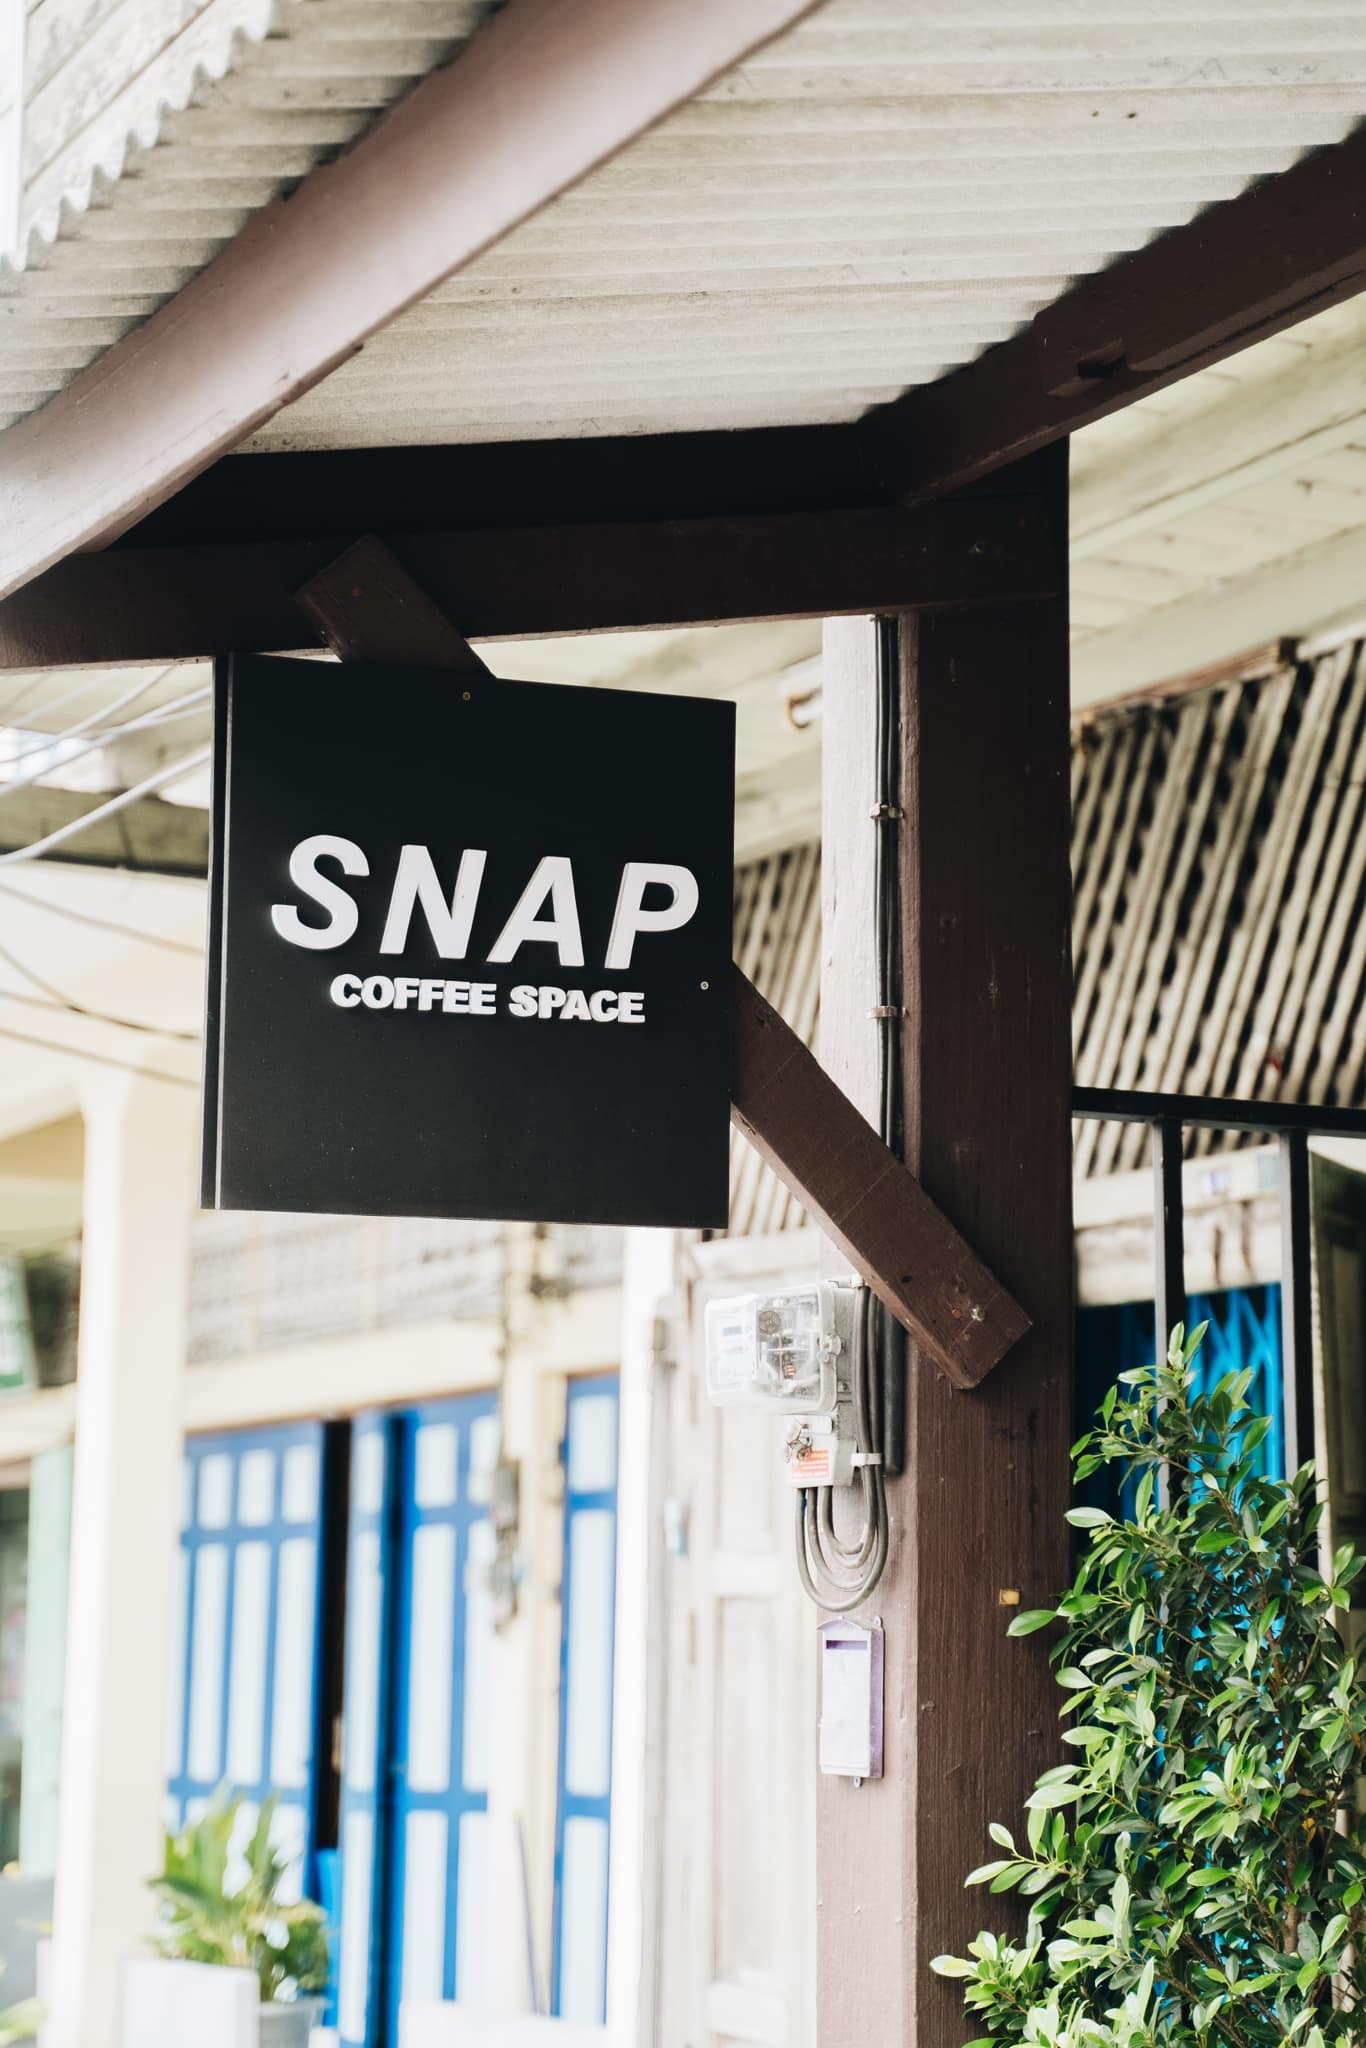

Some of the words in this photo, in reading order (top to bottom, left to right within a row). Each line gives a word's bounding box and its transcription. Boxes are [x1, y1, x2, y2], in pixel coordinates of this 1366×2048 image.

[271, 835, 699, 970] SNAP
[330, 973, 497, 1015] COFFEE
[508, 985, 646, 1023] SPACE
